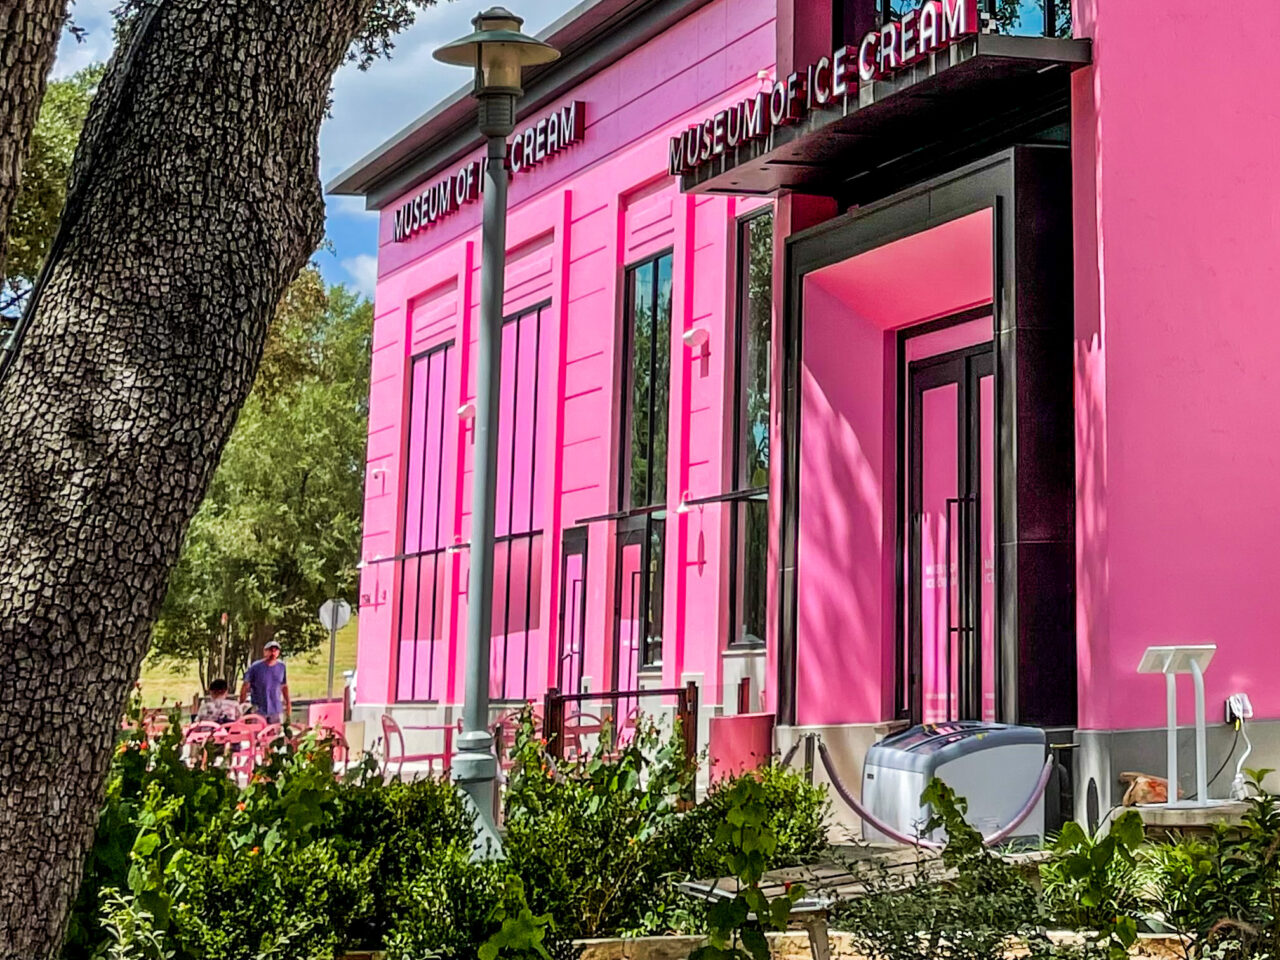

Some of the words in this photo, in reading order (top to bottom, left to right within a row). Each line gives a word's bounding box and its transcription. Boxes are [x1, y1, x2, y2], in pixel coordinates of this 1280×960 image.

[394, 176, 459, 243] MUSEUM
[456, 161, 479, 205] OF
[508, 100, 586, 173] CREAM
[668, 92, 770, 176] MUSEUM
[770, 72, 806, 127] OF
[806, 45, 858, 110] ICE
